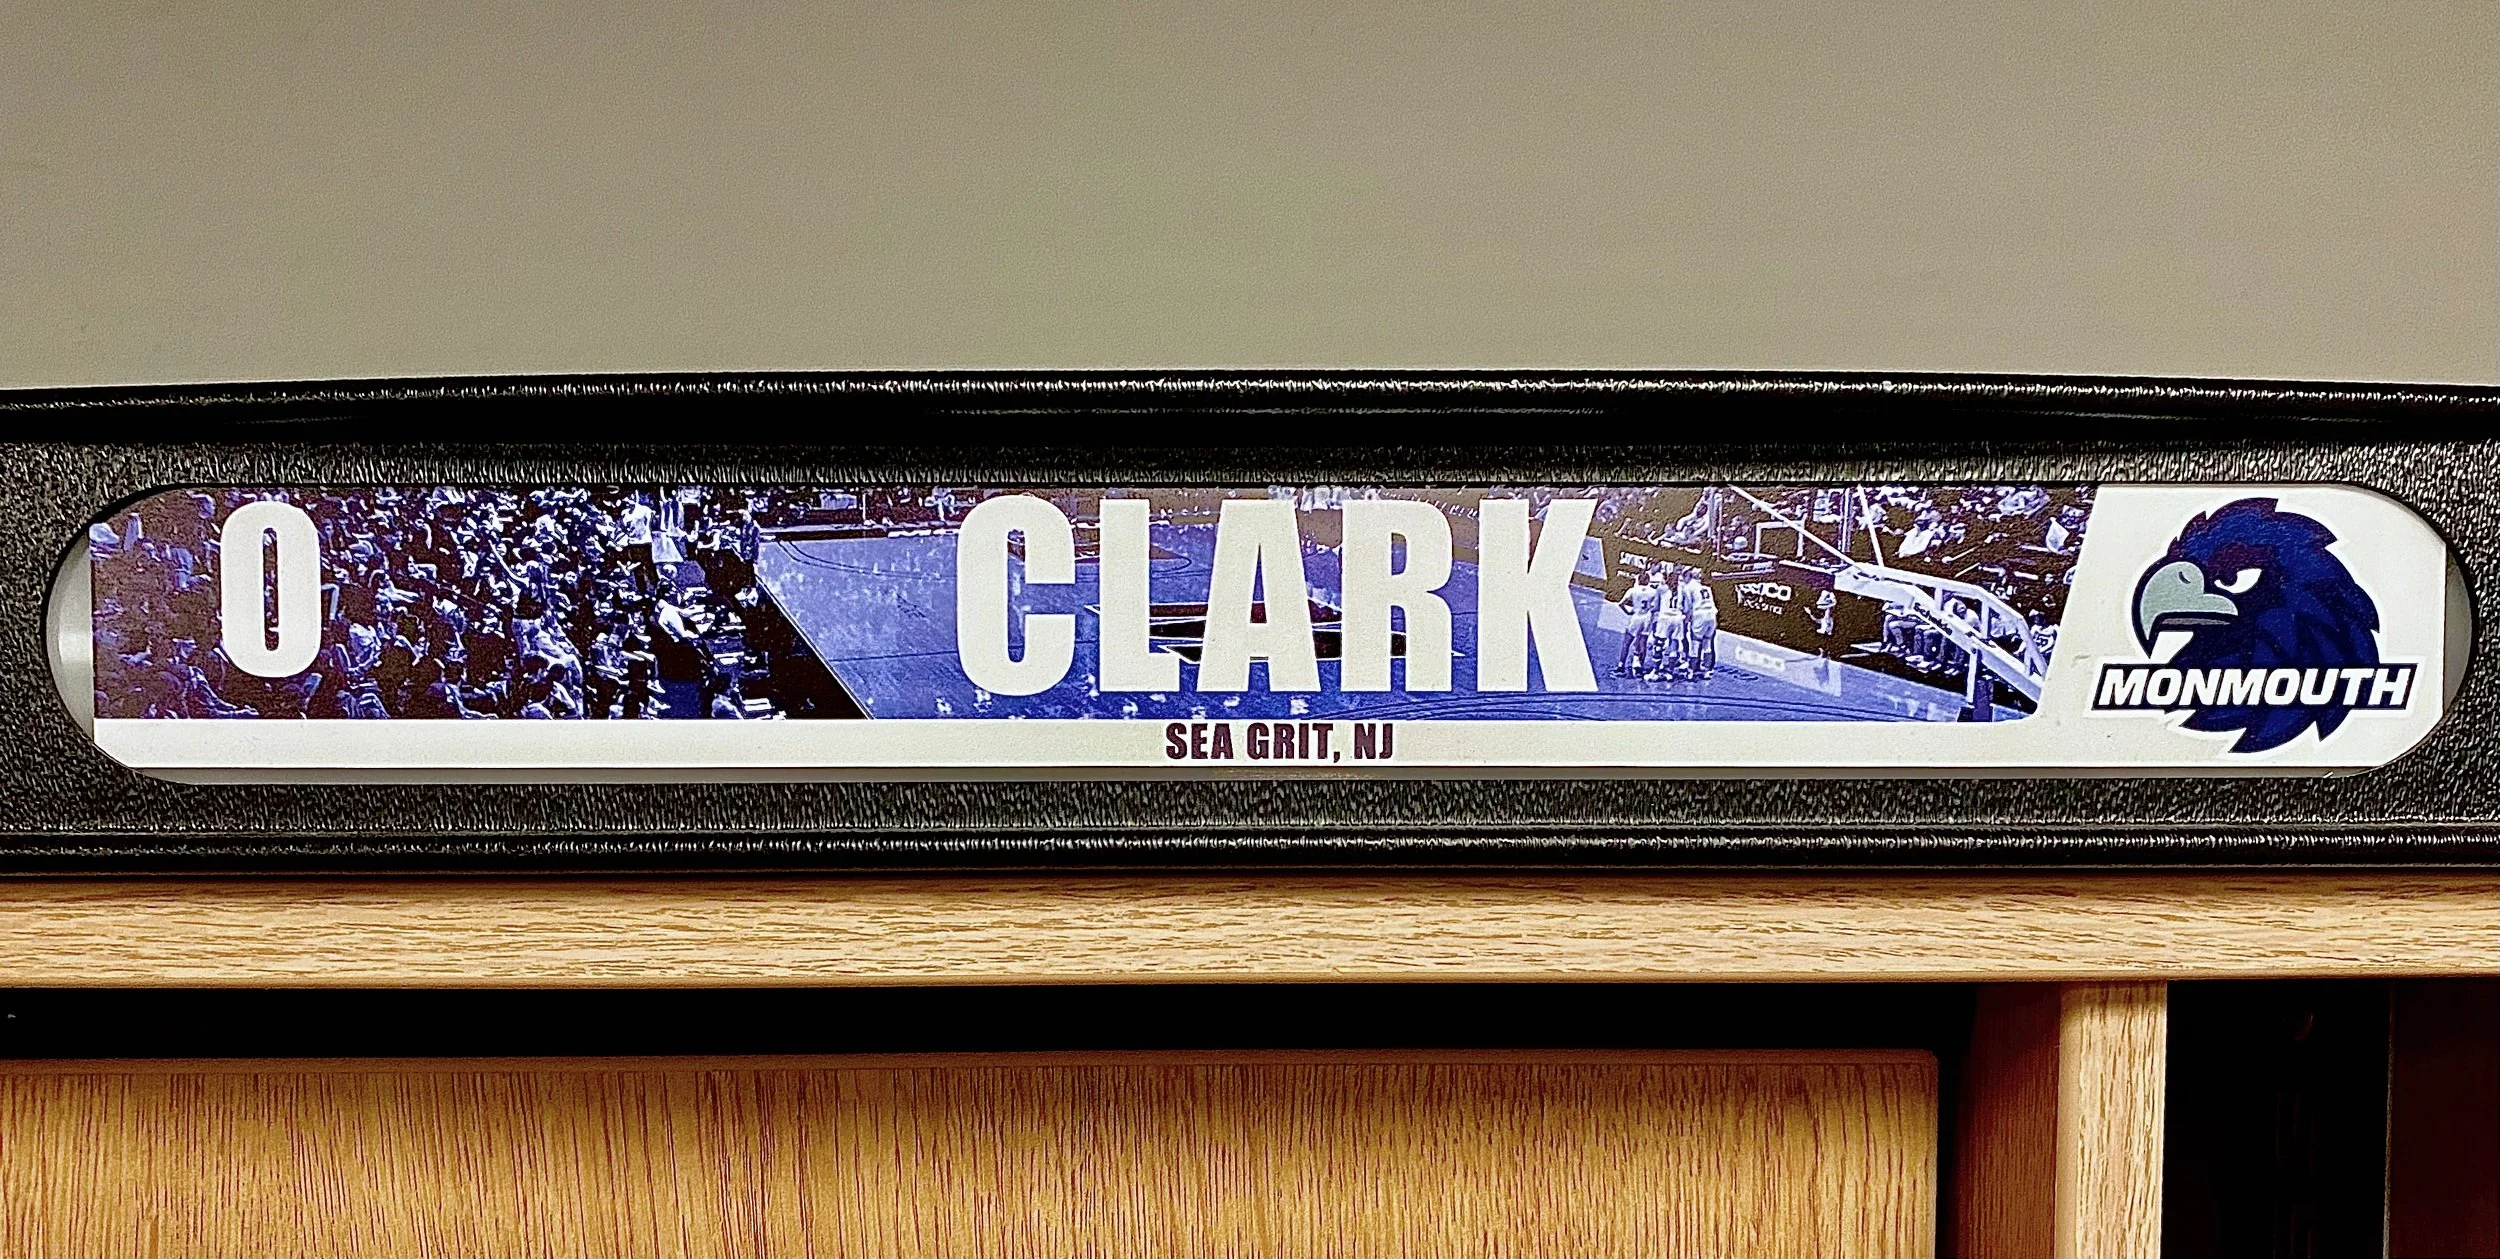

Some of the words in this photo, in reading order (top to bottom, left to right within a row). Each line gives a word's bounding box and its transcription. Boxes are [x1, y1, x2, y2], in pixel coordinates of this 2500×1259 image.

[956, 494, 1599, 696] CLARK
[2099, 667, 2412, 706] MONMOUTH
[1165, 722, 1234, 759] SEA
[1246, 722, 1341, 763] GRIT,
[1353, 722, 1394, 759] NJ
